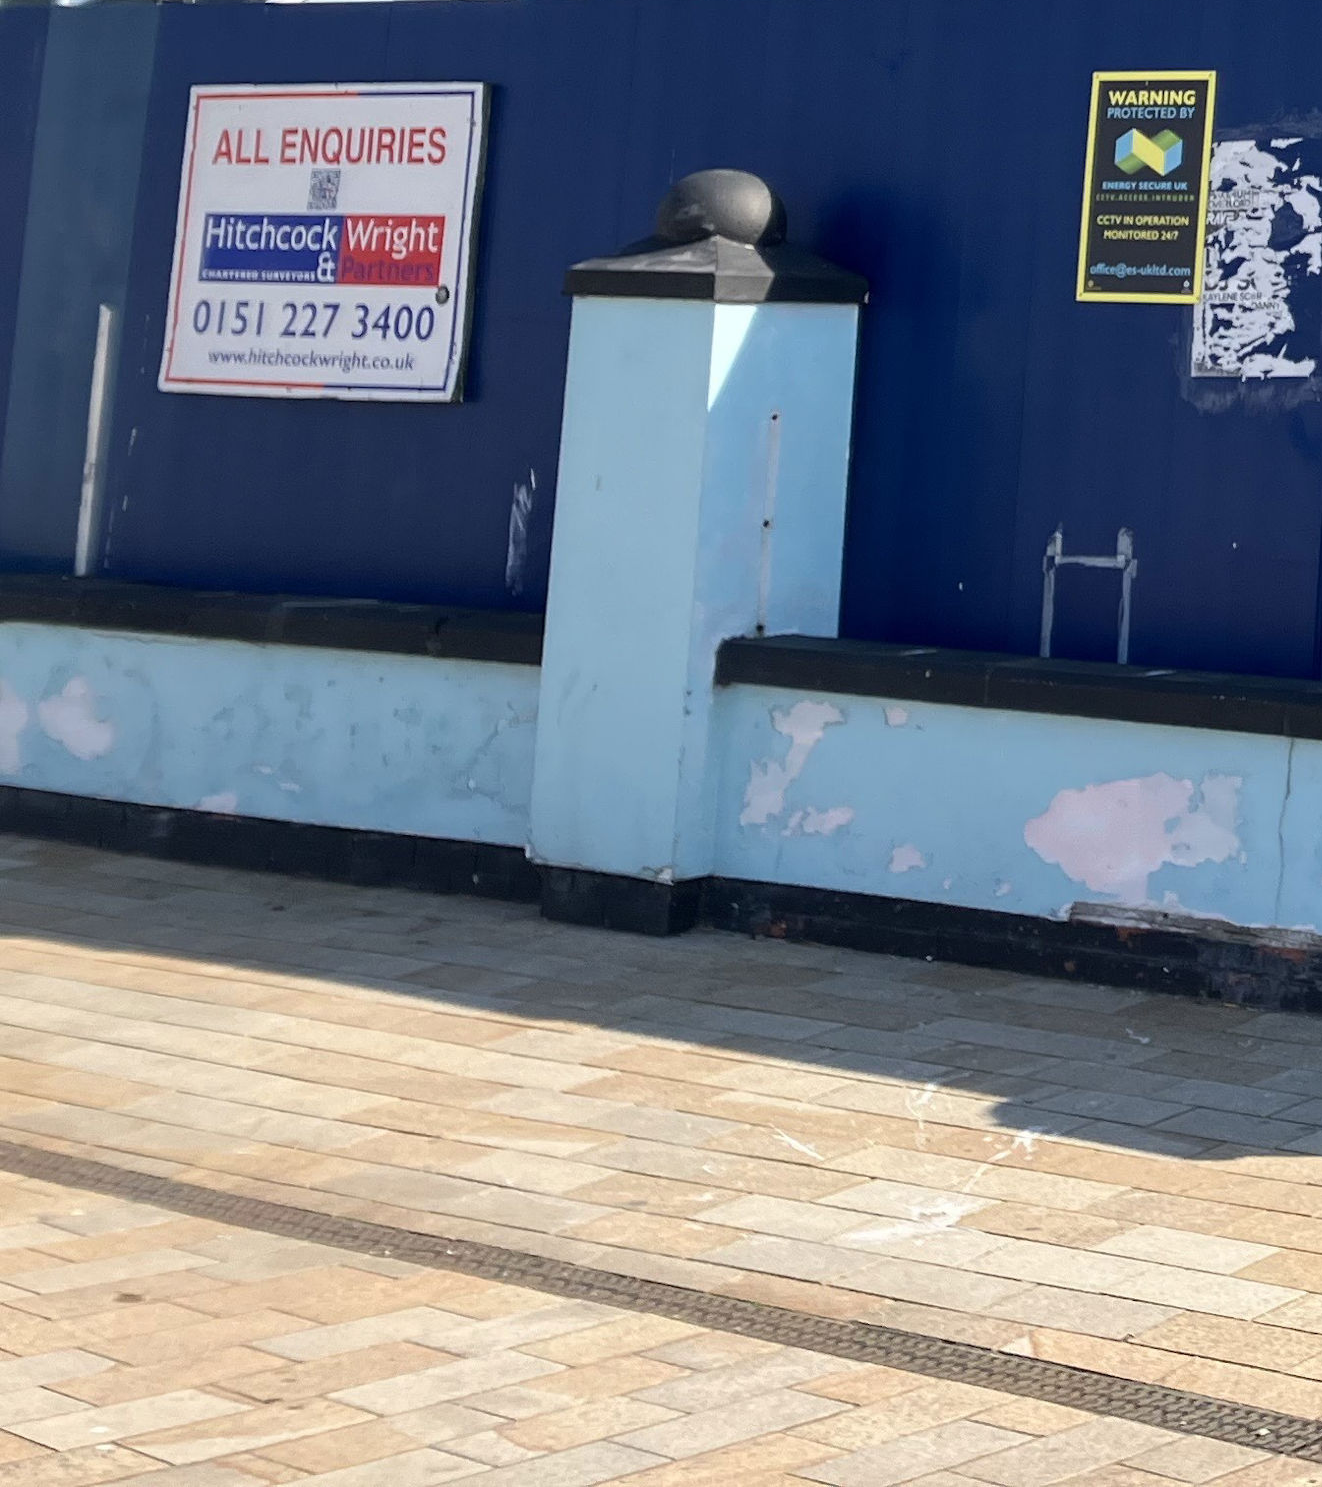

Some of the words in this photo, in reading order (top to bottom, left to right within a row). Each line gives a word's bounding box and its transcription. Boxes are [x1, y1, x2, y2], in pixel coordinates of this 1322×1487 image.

[1108, 90, 1196, 106] WARNING
[1106, 106, 1177, 119] PROTECTED
[1179, 106, 1196, 119] BY
[211, 128, 270, 165] ALL
[279, 125, 448, 166] ENQUIRIES
[1102, 181, 1137, 191] ENERGY
[1138, 181, 1172, 191] SECURE
[1173, 181, 1188, 191] UK
[1096, 215, 1122, 226] CCTV
[1123, 215, 1134, 226] IN
[1135, 215, 1190, 227] OPERATION
[205, 216, 338, 251] Hitchcock
[346, 218, 440, 261] Wright
[1103, 230, 1159, 240] MONITORED
[1160, 231, 1180, 241] 24/7
[316, 251, 336, 283] &
[341, 256, 434, 281] Partners
[1089, 262, 1191, 279] office@es-ukltd.com
[193, 299, 265, 336] 0151
[280, 303, 341, 338] 227
[350, 303, 436, 340] 3400
[207, 349, 415, 373] www.hitchcockwright.co.uk
